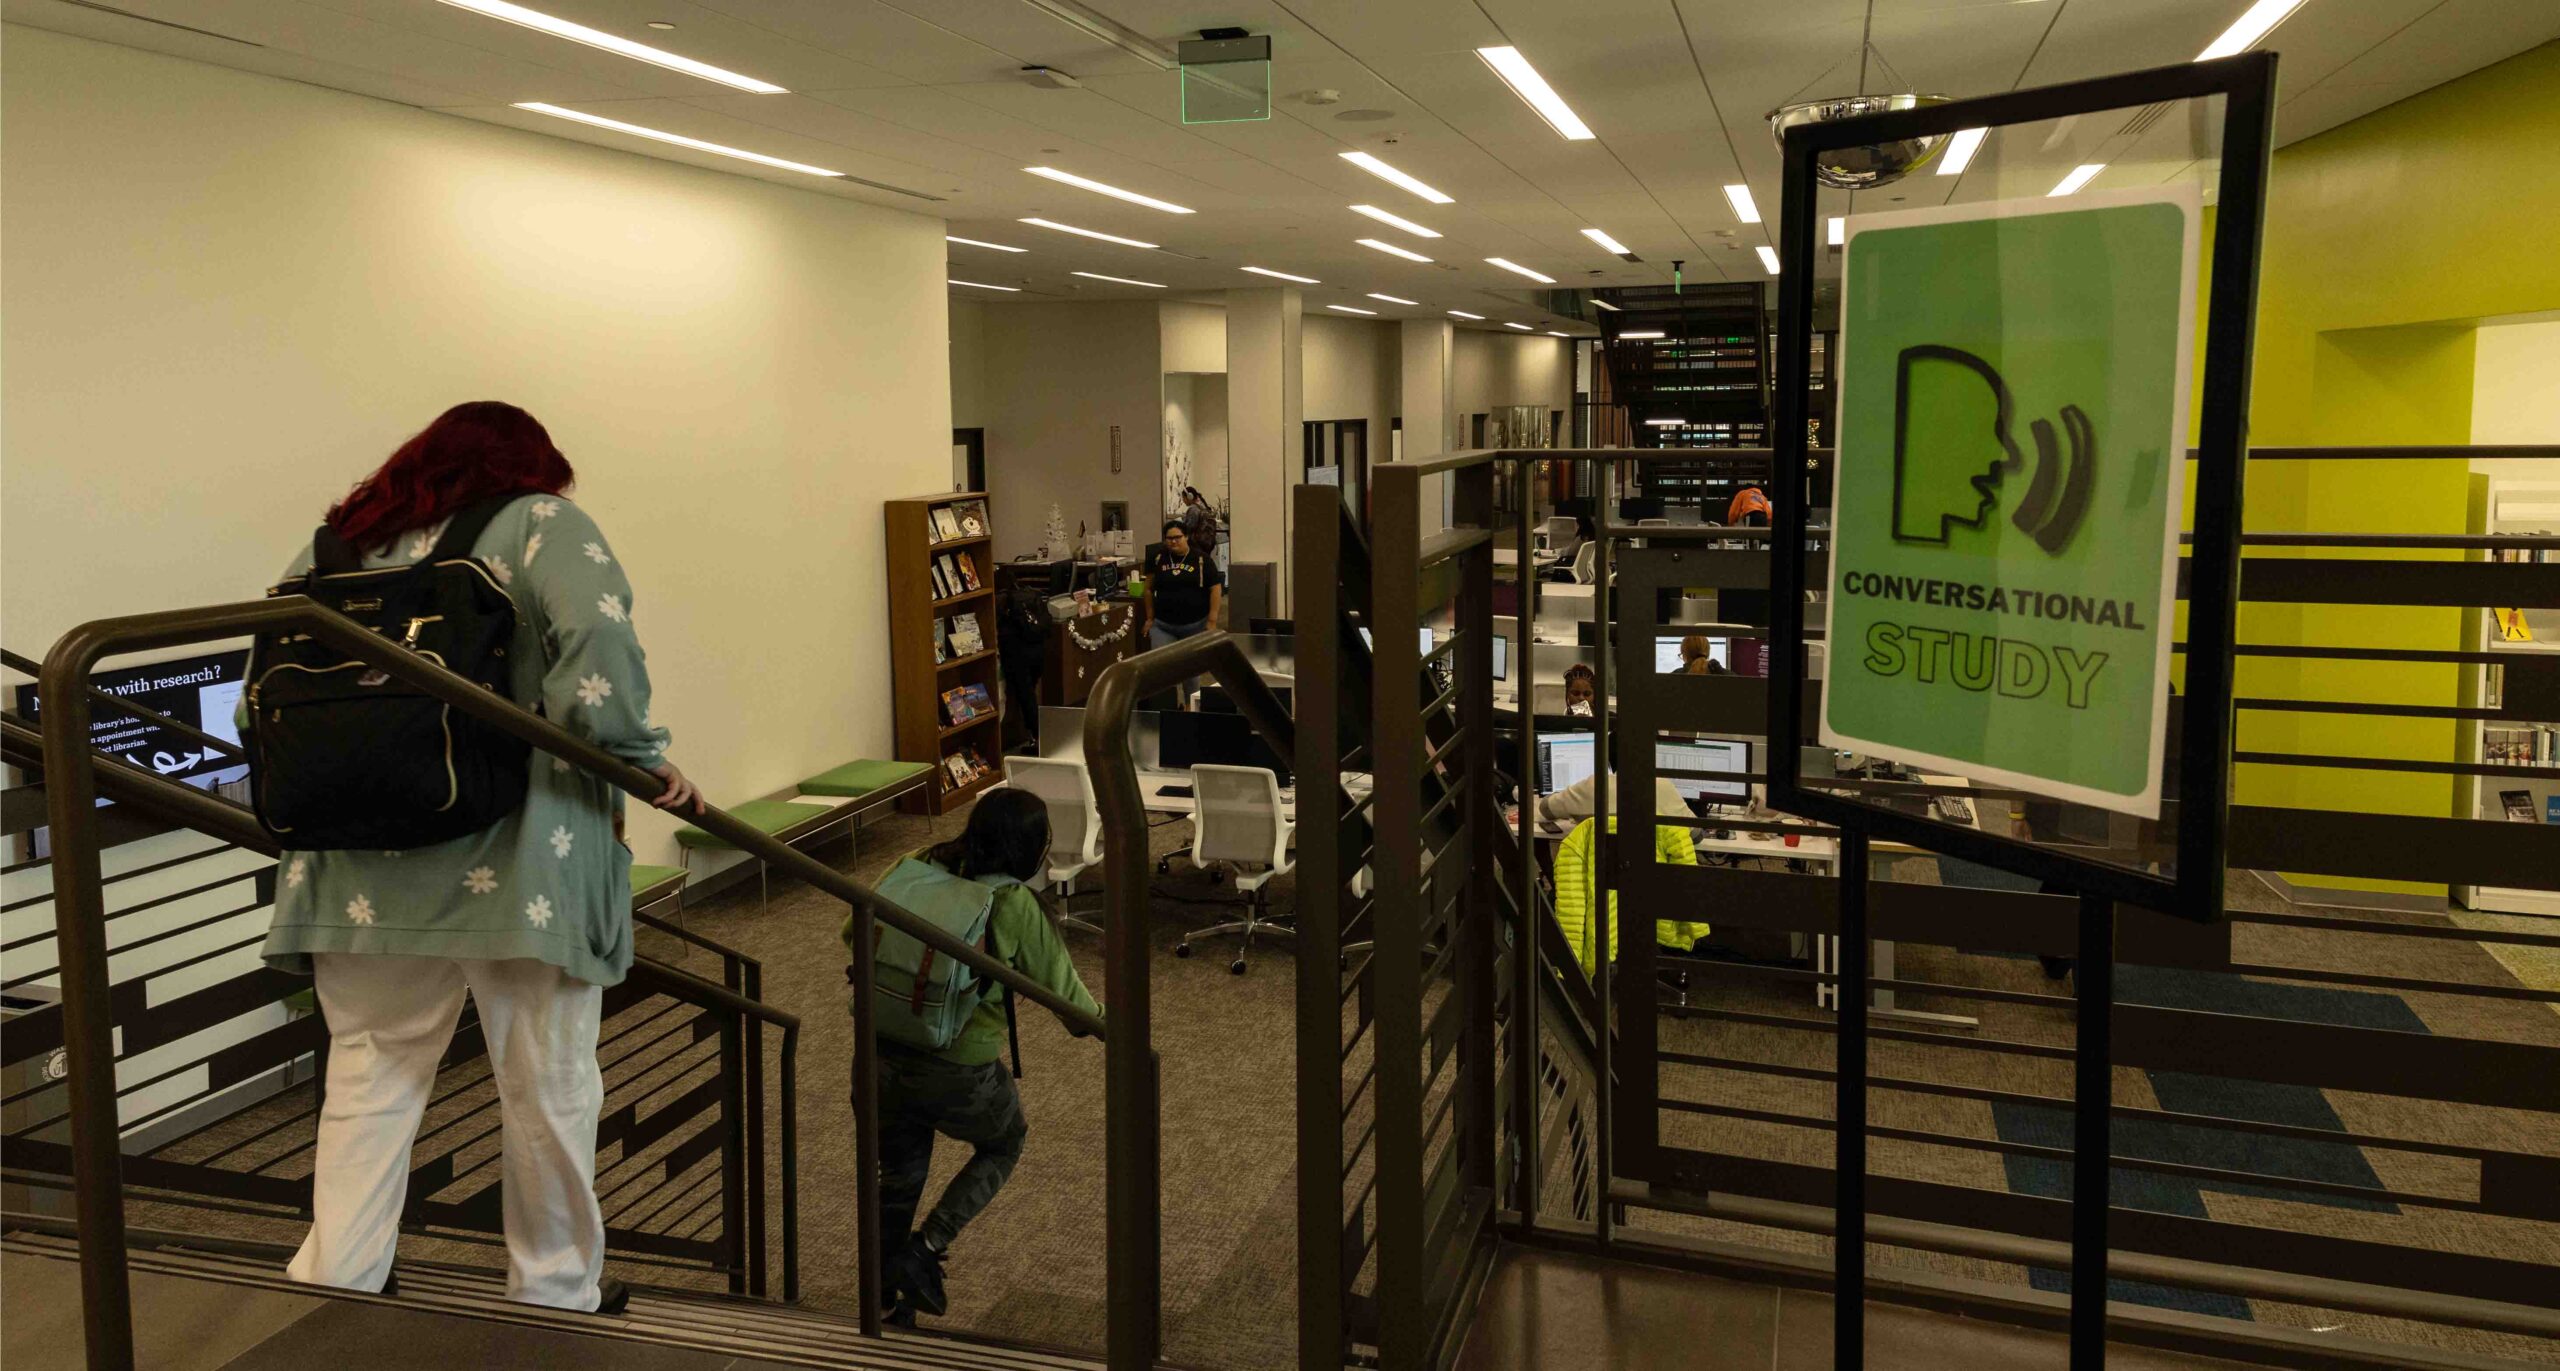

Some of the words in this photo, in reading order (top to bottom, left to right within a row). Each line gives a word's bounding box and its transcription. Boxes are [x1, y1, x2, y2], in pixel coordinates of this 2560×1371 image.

[1843, 571, 2146, 631] CONVERSATIONAL
[1863, 621, 2110, 710] STUDY
[115, 677, 151, 697] with
[152, 664, 221, 690] research?
[93, 718, 125, 731] library's
[96, 727, 145, 744] appointment
[113, 739, 148, 752] librarian.
